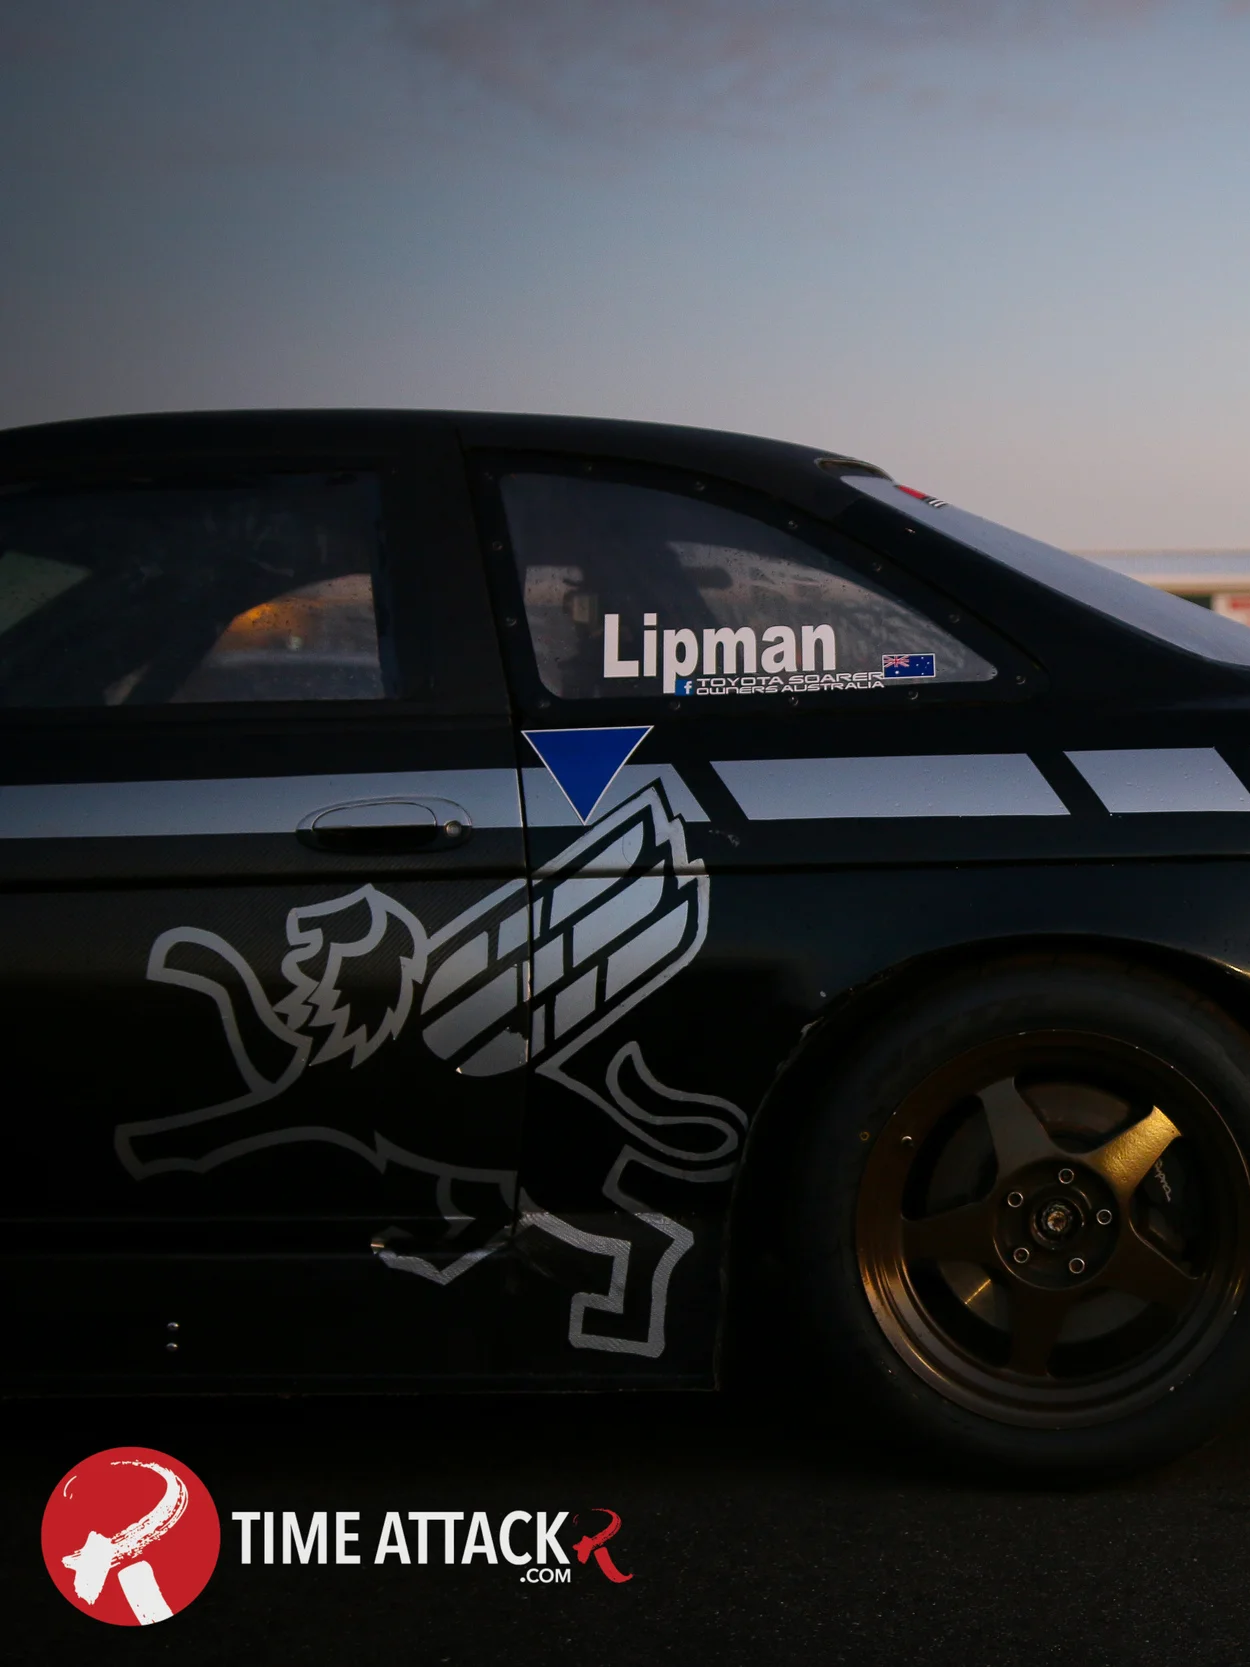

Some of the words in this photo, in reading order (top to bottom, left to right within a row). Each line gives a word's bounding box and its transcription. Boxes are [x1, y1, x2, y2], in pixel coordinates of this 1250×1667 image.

[603, 612, 837, 694] Lipman
[696, 675, 783, 687] TOYOTA
[787, 671, 885, 684] SOARER
[780, 680, 886, 693] AUSTRALIA
